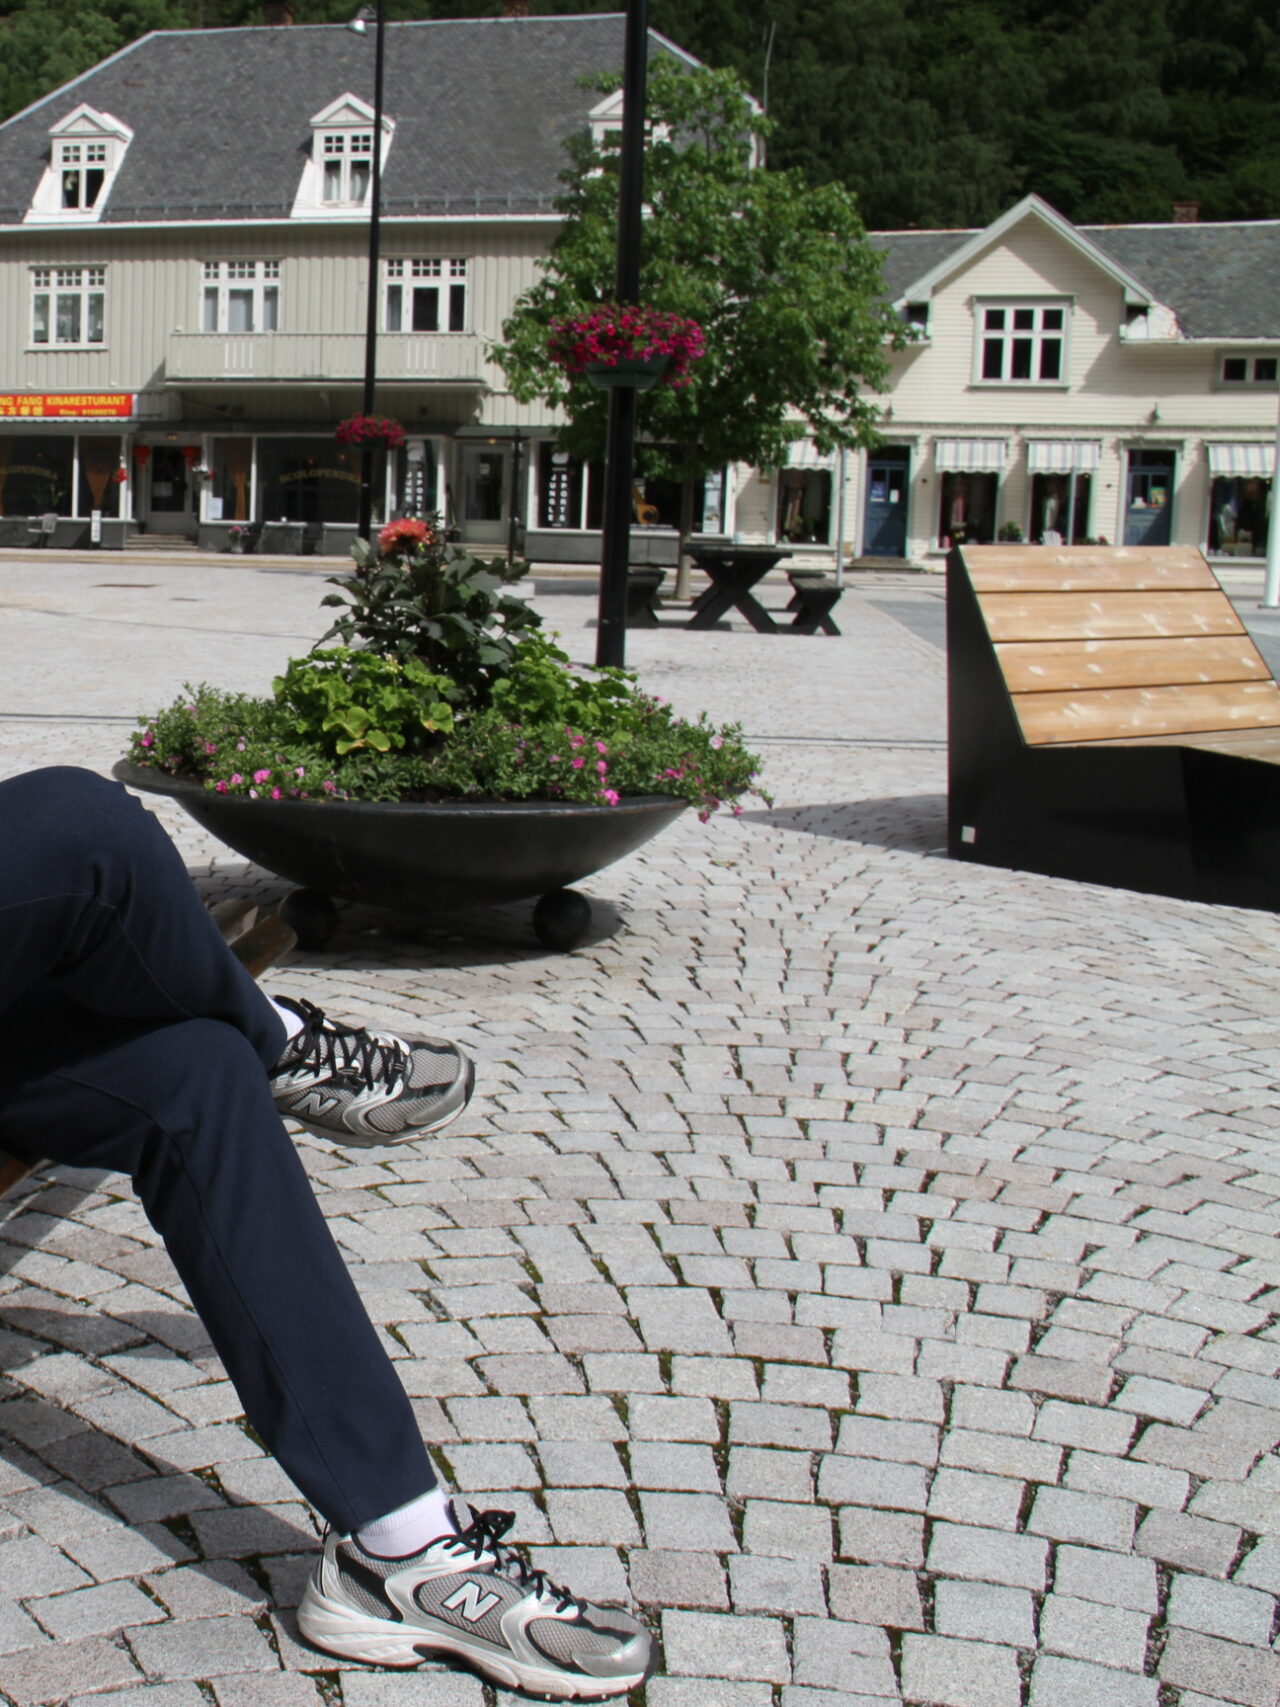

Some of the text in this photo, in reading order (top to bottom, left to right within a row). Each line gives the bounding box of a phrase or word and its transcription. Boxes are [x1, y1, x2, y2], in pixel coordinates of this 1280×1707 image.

[16, 396, 43, 406] FANG
[46, 395, 126, 406] KINARESTURANT
[548, 474, 557, 522] JUNGLE
[559, 474, 568, 522] SPORTS
[290, 1092, 339, 1117] N
[441, 1580, 502, 1623] N
